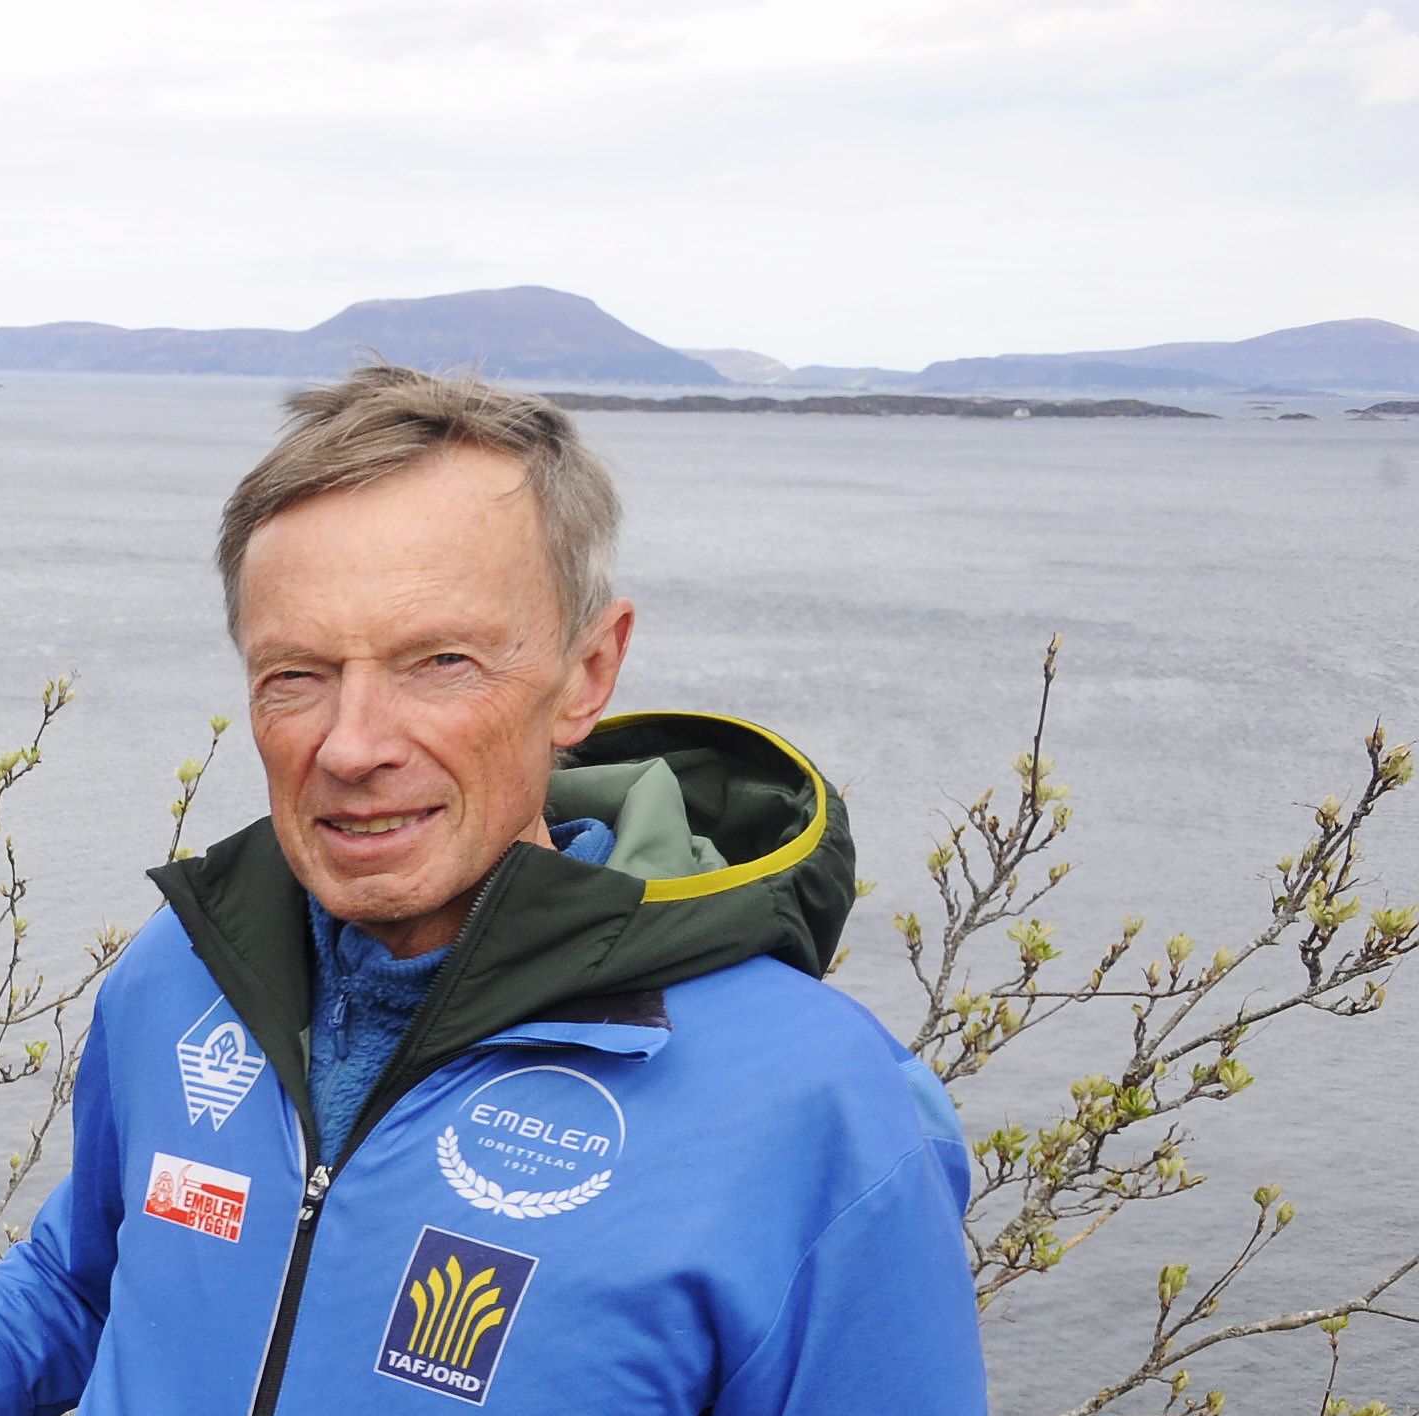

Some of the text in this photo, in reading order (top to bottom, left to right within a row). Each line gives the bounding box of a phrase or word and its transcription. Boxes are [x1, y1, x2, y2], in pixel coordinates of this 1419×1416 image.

[470, 1103, 611, 1157] EMBLEM
[477, 1137, 577, 1171] IDRETTSLAG
[184, 1190, 244, 1223] EMBLEM
[387, 1350, 481, 1392] TAFJORD
